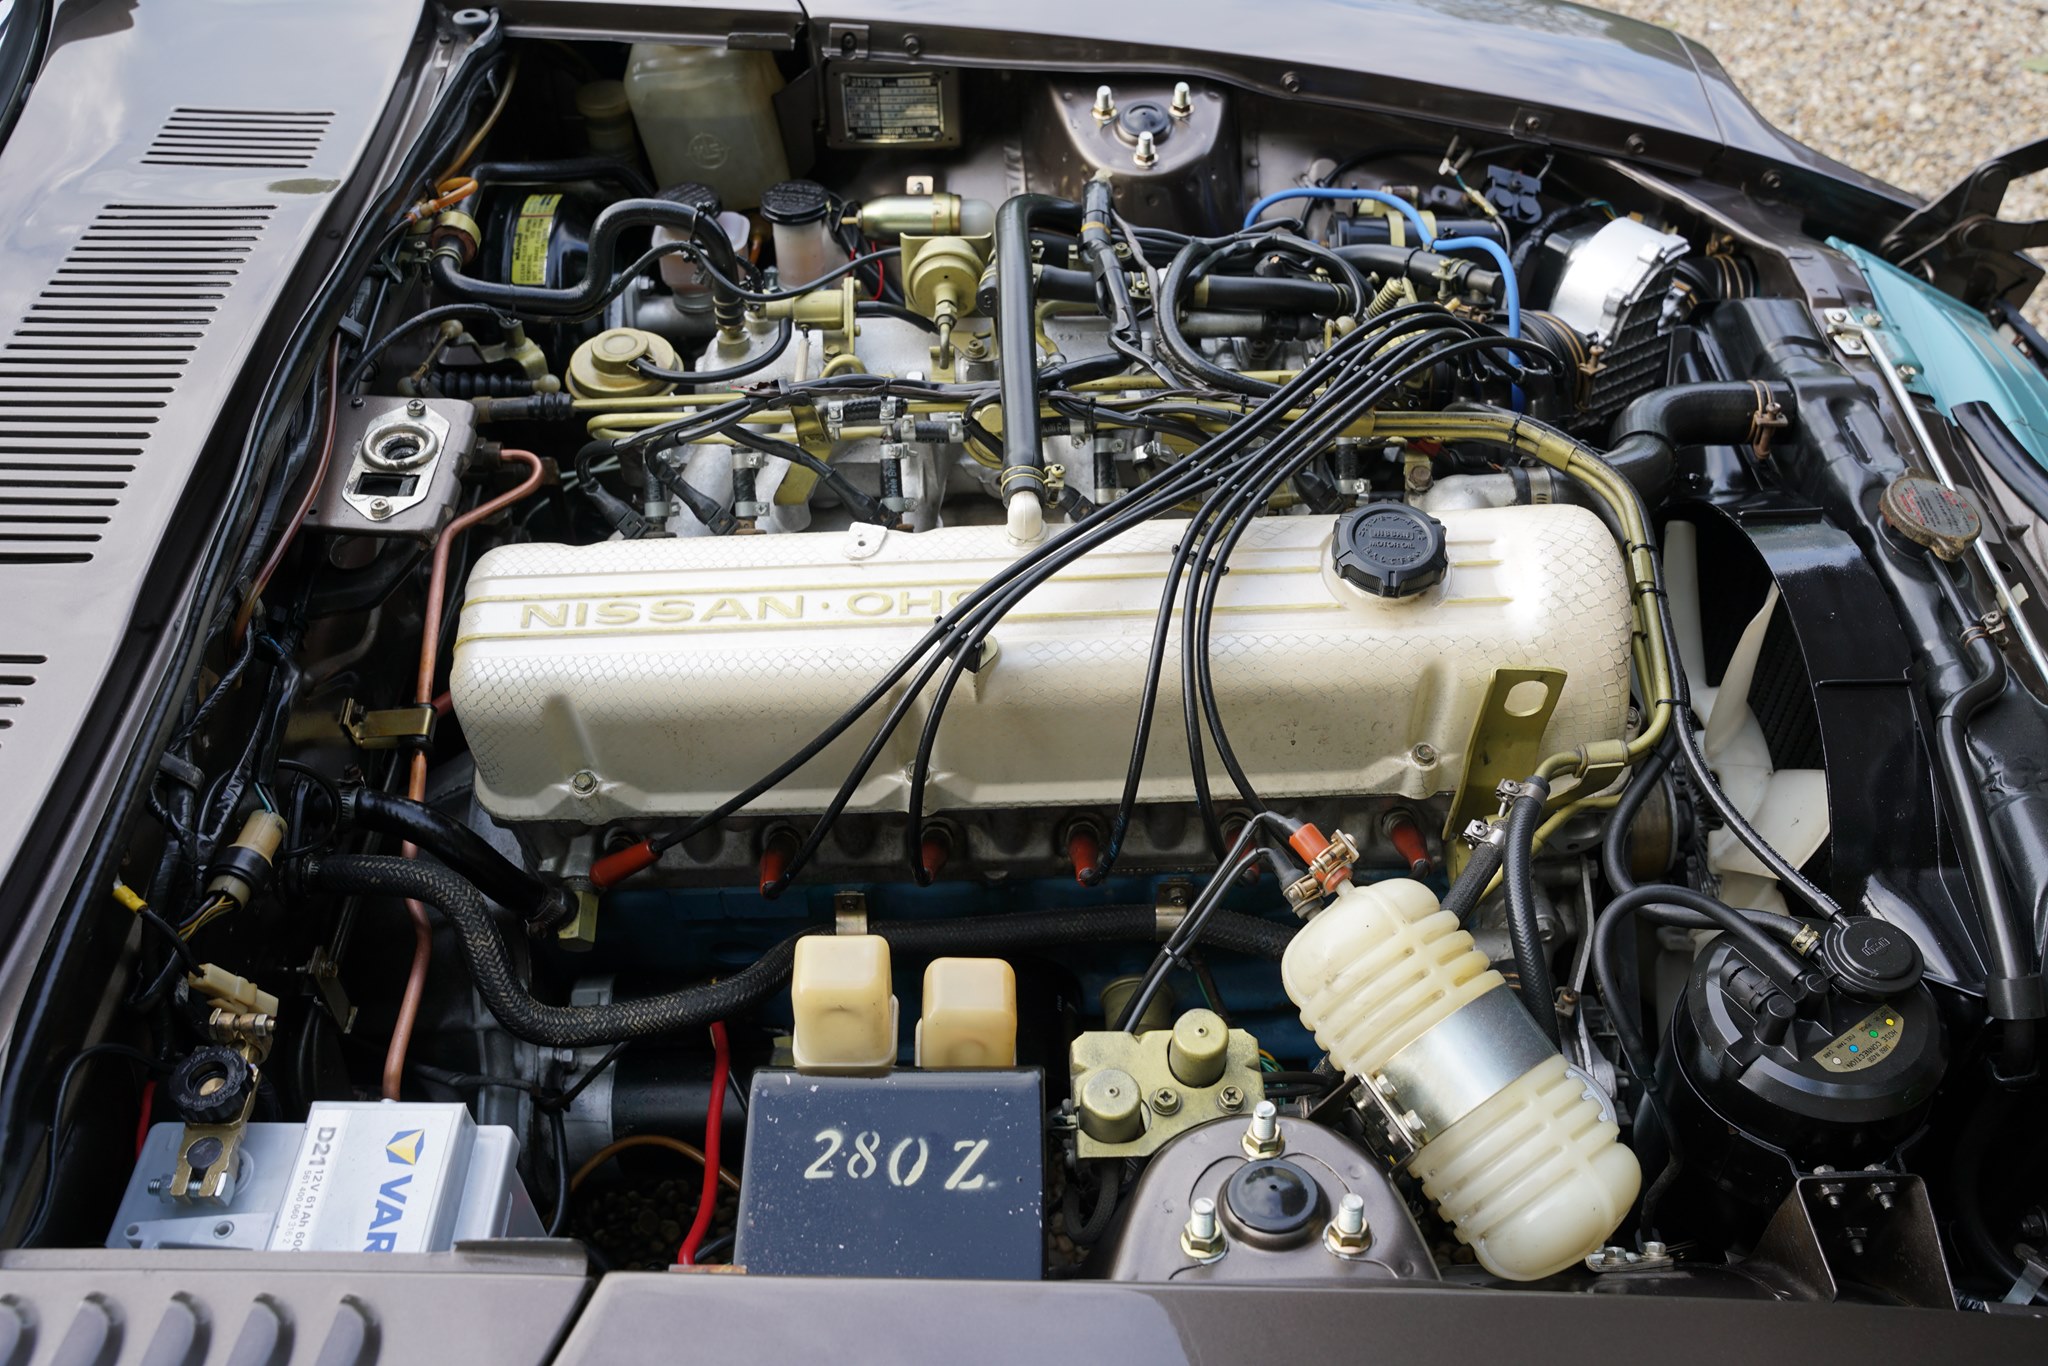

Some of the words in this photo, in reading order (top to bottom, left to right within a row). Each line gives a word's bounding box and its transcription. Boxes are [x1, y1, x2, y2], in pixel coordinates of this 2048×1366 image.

[520, 594, 804, 629] NISSAN
[1881, 1029, 1898, 1043] HOSE
[1846, 1040, 1882, 1069] CONNECTION
[309, 1127, 337, 1165] D21
[804, 1129, 928, 1187] 280
[944, 1138, 989, 1190] Z
[310, 1169, 324, 1191] 12V
[363, 1174, 413, 1252] VAR
